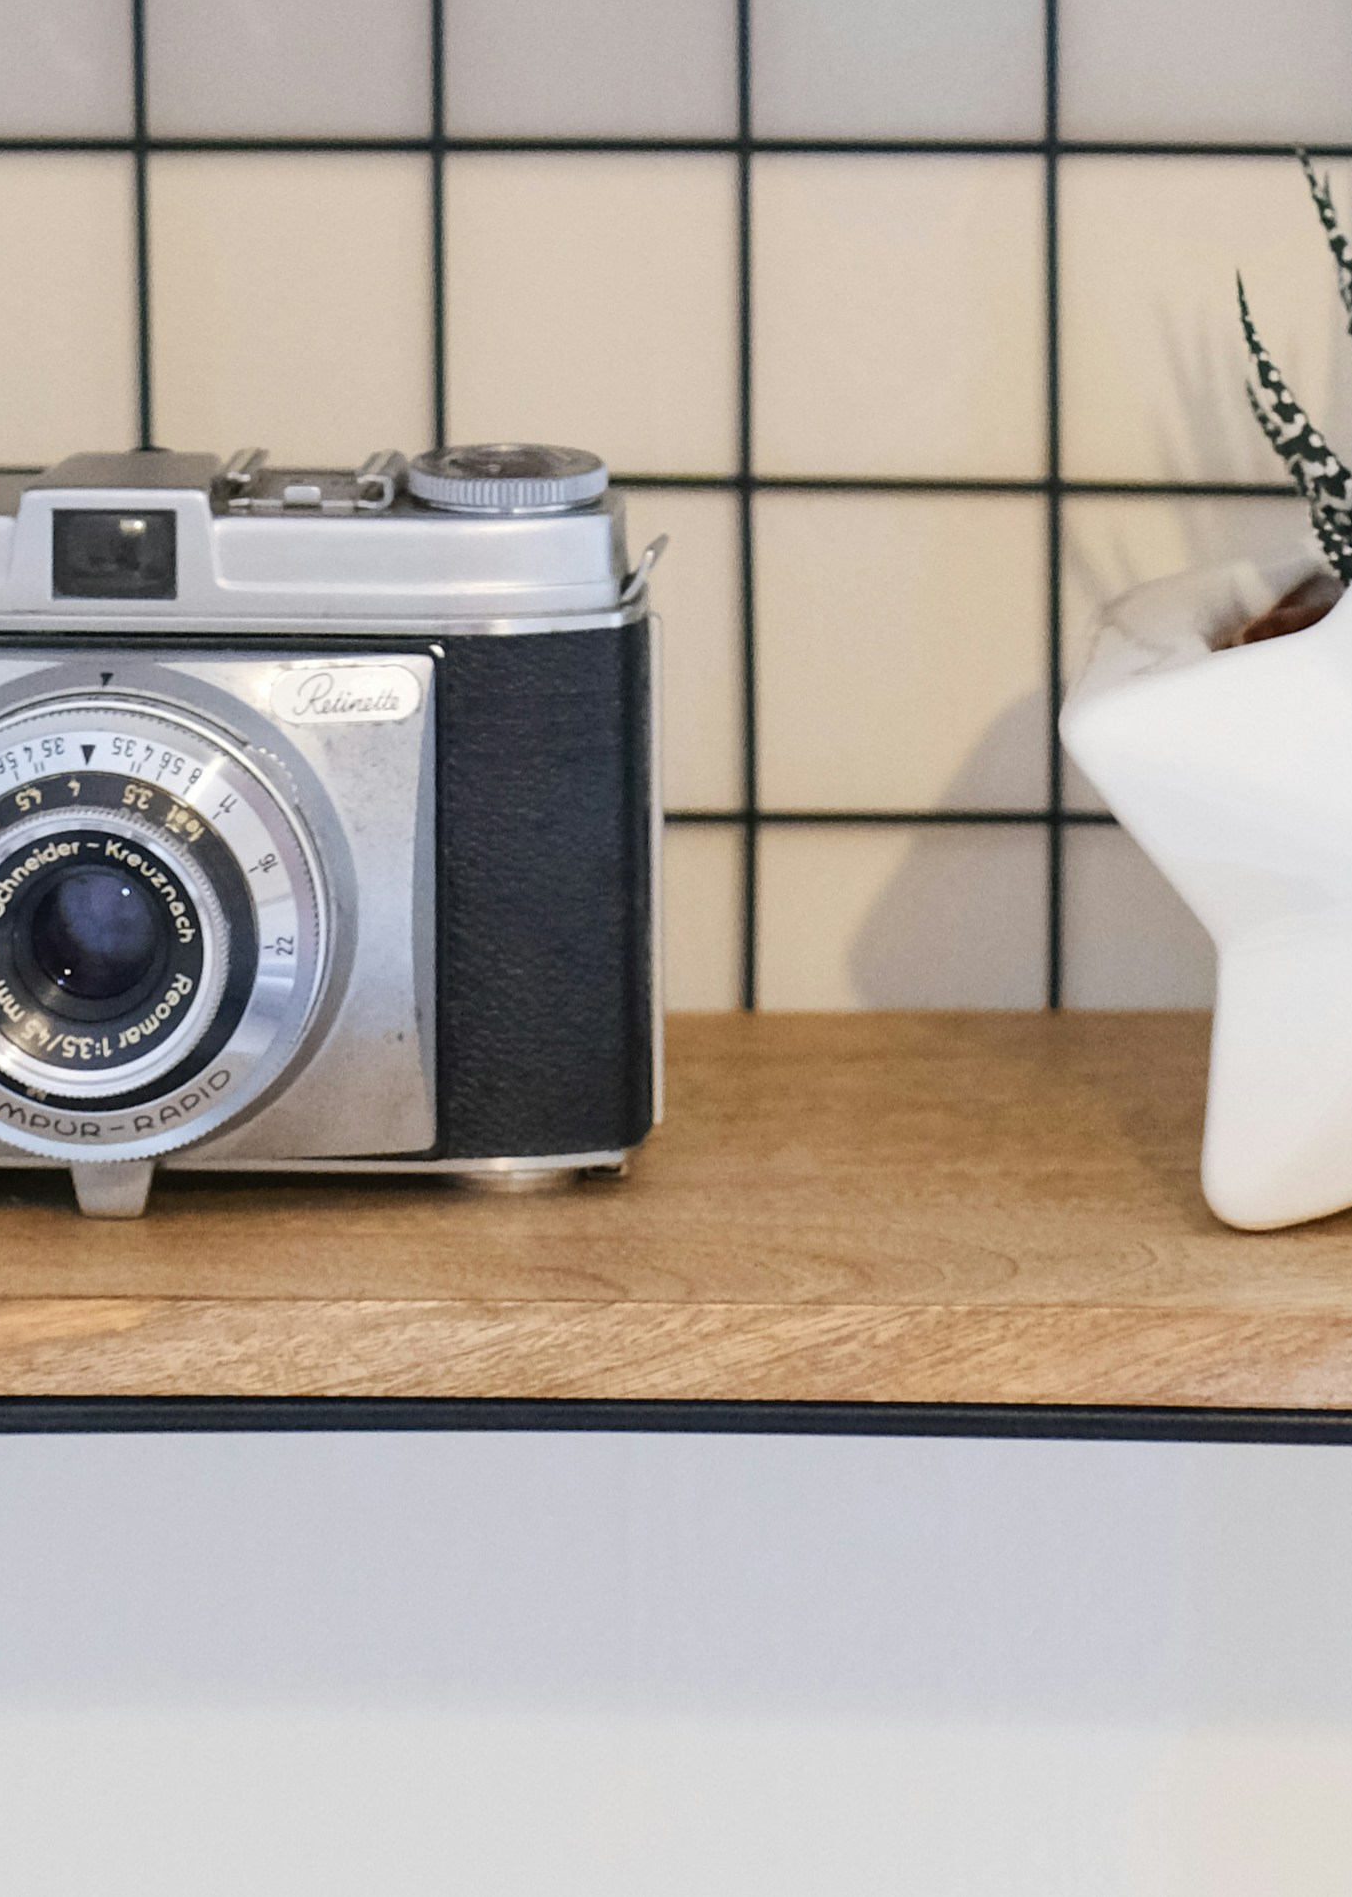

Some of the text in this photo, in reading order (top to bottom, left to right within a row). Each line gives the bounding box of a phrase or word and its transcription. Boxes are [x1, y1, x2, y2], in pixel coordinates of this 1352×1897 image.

[291, 672, 400, 716] Retinette
[104, 839, 196, 944] Kreuznach
[118, 973, 194, 1048] Reomar
